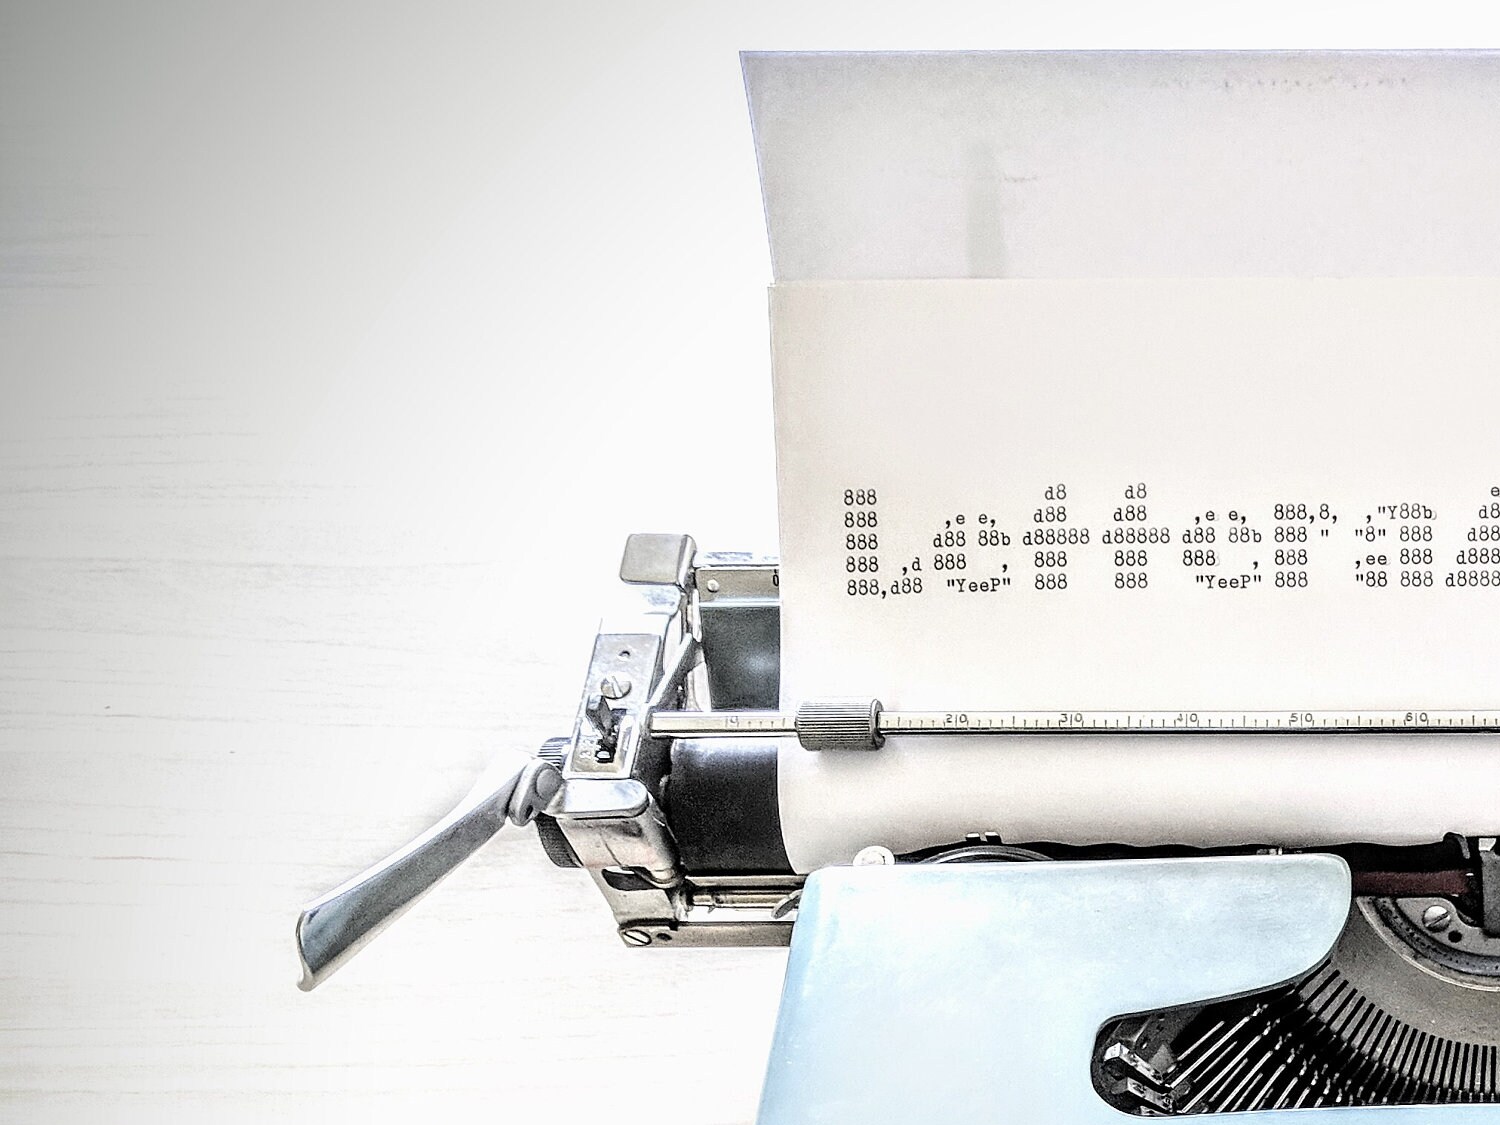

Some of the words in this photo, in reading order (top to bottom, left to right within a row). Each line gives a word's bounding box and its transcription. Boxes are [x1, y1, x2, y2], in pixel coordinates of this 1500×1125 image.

[843, 488, 877, 506] 888
[1045, 484, 1067, 500] d8
[1125, 483, 1147, 499] d8
[843, 511, 878, 528] 888
[1034, 506, 1067, 523] d88
[1113, 505, 1147, 521] d88
[845, 533, 878, 550] 888
[933, 530, 966, 548] d88
[978, 530, 1011, 546] 88b
[1023, 527, 1090, 546] d88888
[1102, 527, 1170, 544] d88888
[1182, 527, 1215, 544] d88
[1228, 527, 1262, 543] 88b
[1274, 526, 1307, 543] 888
[1400, 526, 1432, 542] 888
[846, 556, 878, 573] 888
[934, 553, 966, 570] 888
[1034, 551, 1067, 568] 888
[1114, 550, 1147, 566] 888
[1182, 549, 1215, 566] 888
[1274, 549, 1307, 565] 888
[1400, 548, 1433, 564] 888
[947, 577, 1010, 592] "YeeP"
[1034, 573, 1067, 590] 888
[1114, 572, 1148, 589] 888
[1196, 575, 1261, 589] "YeeP"
[1275, 571, 1308, 588] 888
[1400, 571, 1433, 587] 888
